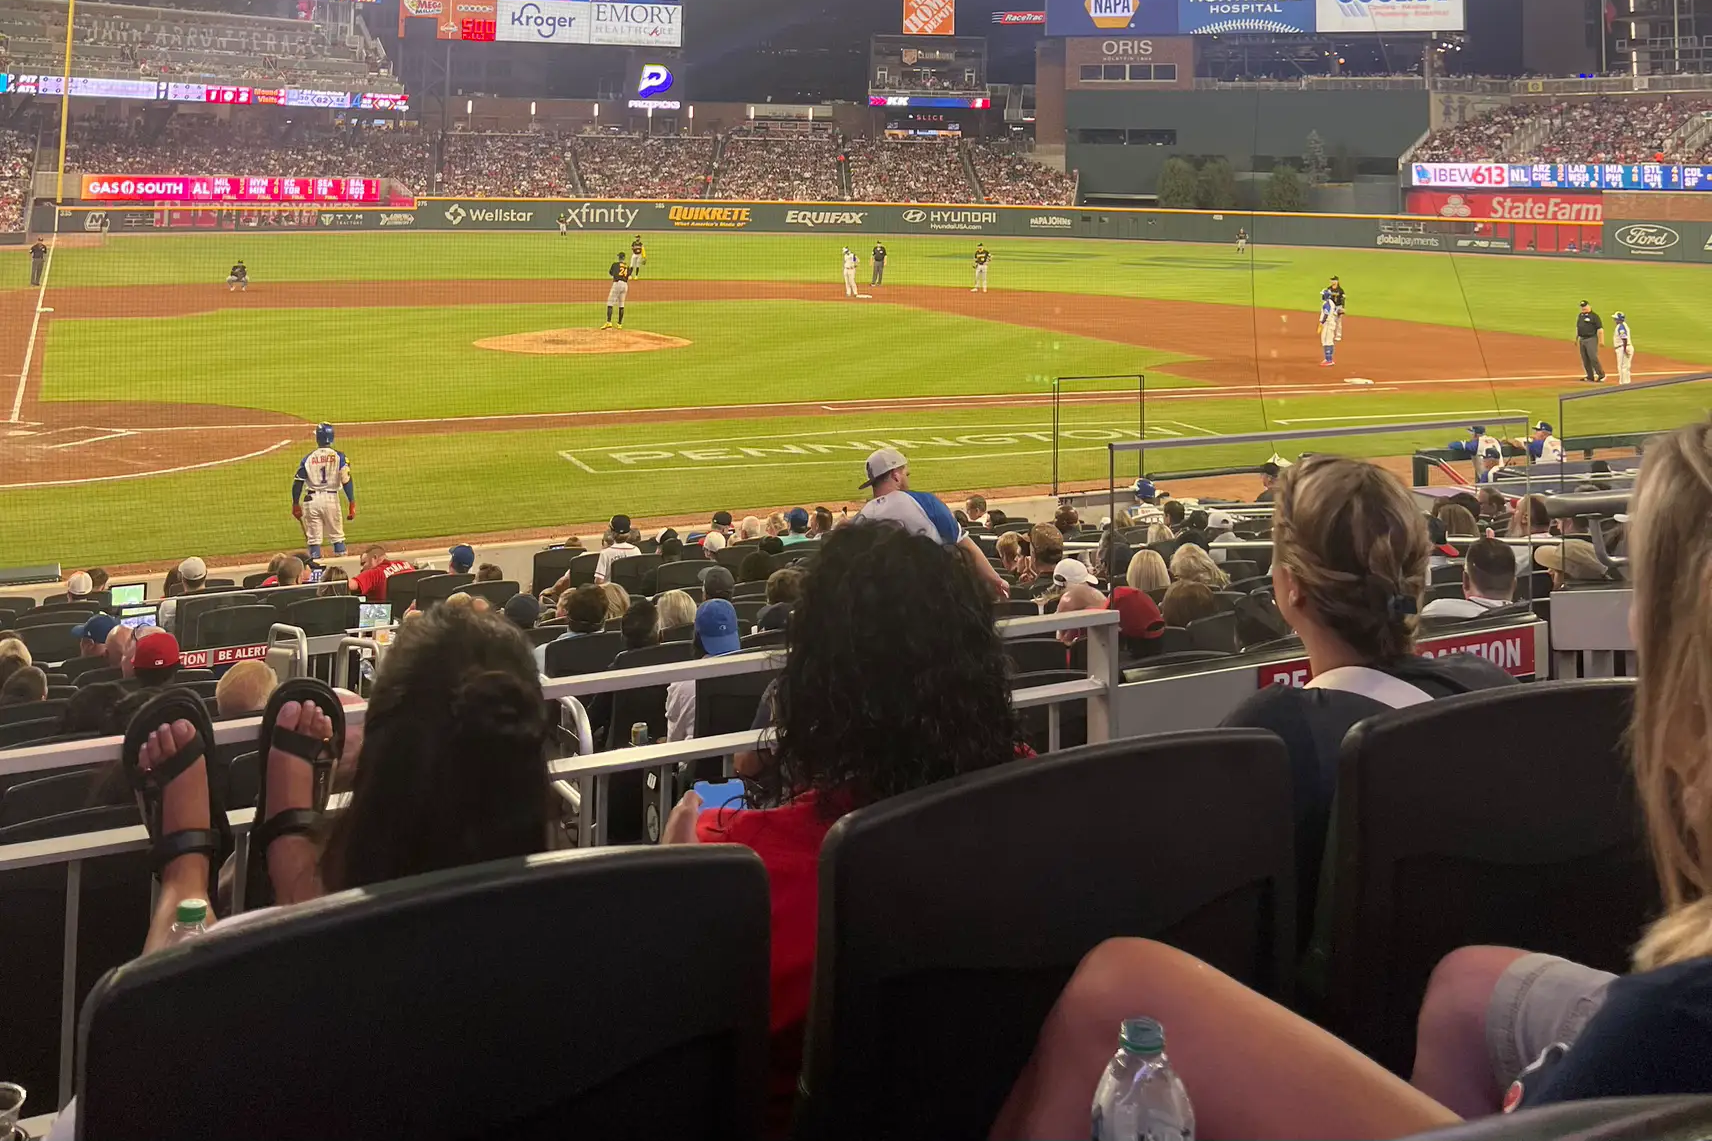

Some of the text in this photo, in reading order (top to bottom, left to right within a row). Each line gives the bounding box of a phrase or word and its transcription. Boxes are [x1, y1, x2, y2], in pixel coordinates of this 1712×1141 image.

[595, 4, 677, 24] EMORY
[1210, 3, 1283, 14] HOSPITAL
[512, 3, 576, 38] Kroger
[923, 2, 955, 34] DEPOT
[1005, 13, 1043, 22] RaceTrac
[1102, 40, 1153, 55] ORIS
[1511, 169, 1529, 182] NL
[1532, 164, 1550, 172] ARZ
[1684, 167, 1703, 177] COL
[1532, 173, 1551, 181] CHC
[1685, 177, 1699, 187] SF
[89, 182, 120, 195] GAS
[136, 182, 184, 195] SOUTH
[192, 183, 211, 195] AL
[214, 178, 230, 186] MIL
[249, 178, 269, 186] NYM
[317, 179, 333, 187] SEA
[283, 186, 300, 195] TOR
[469, 208, 534, 222] Wellstar
[566, 202, 639, 228] xfinity
[669, 205, 751, 221] QUIKRETE
[785, 210, 865, 227] EQUIFAX
[930, 211, 996, 223] HYUNDAI
[1626, 227, 1668, 246] Ford
[319, 466, 327, 484] 1
[218, 645, 267, 661] BE ALERT
